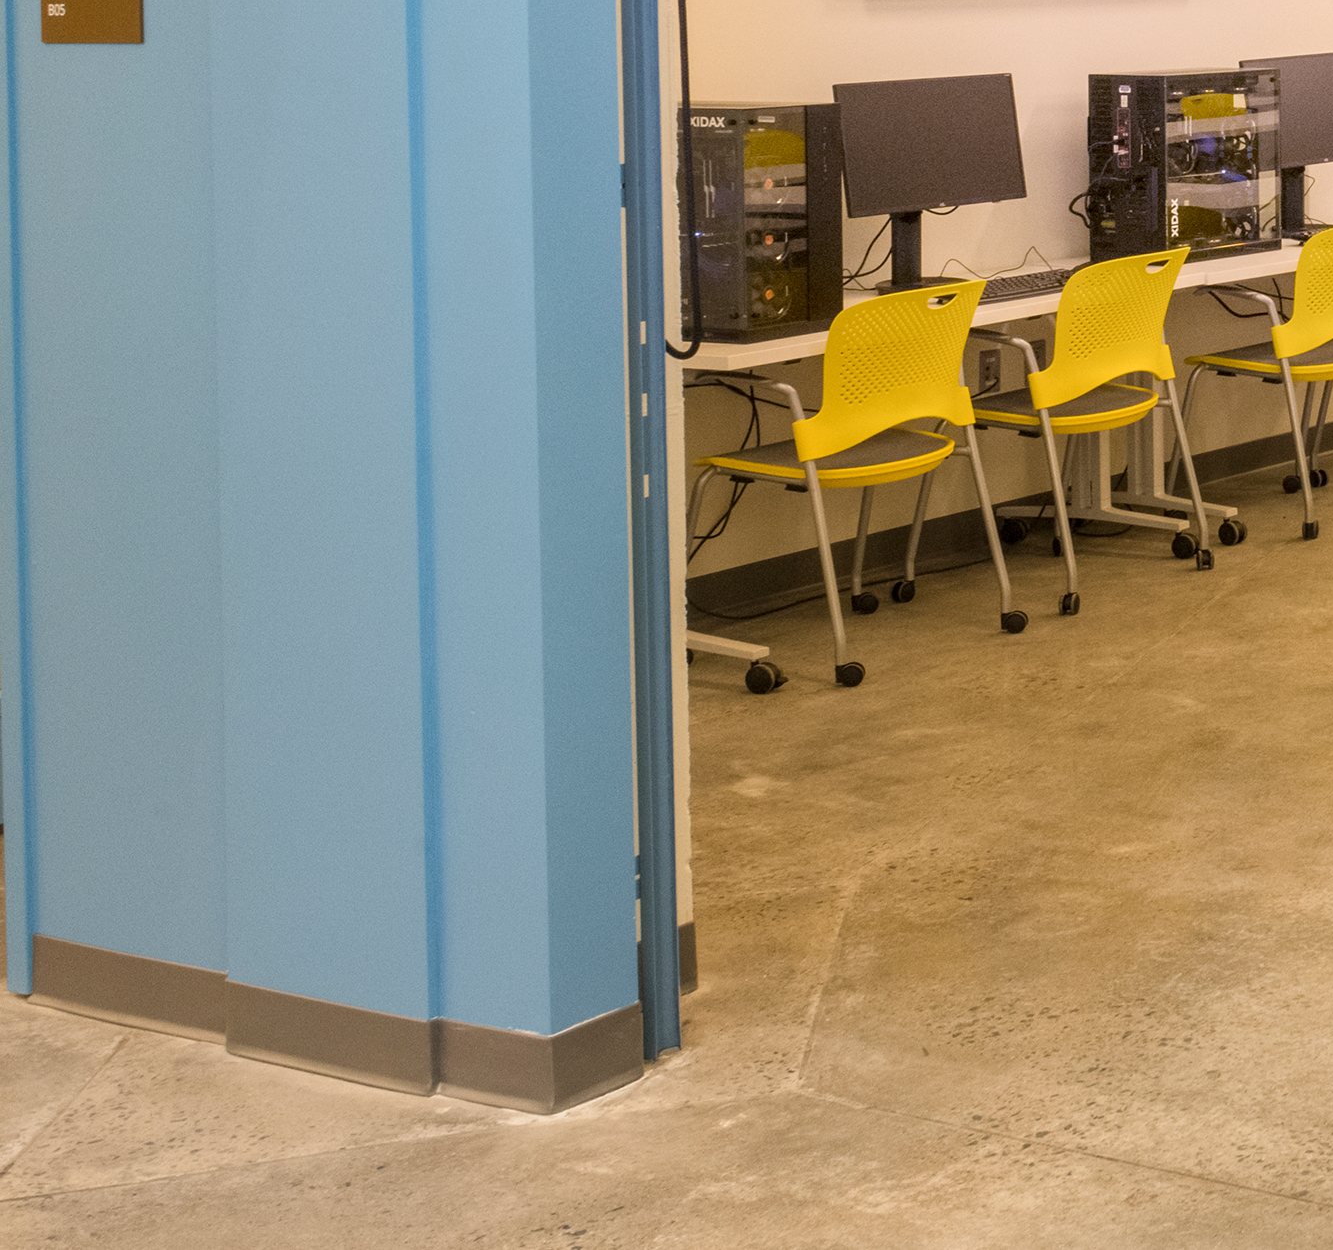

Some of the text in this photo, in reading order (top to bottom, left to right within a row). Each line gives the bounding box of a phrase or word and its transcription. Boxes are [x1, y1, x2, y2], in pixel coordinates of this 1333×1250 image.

[48, 4, 66, 16] B05
[690, 116, 725, 128] XIDAX
[1171, 198, 1179, 237] XIDAX
